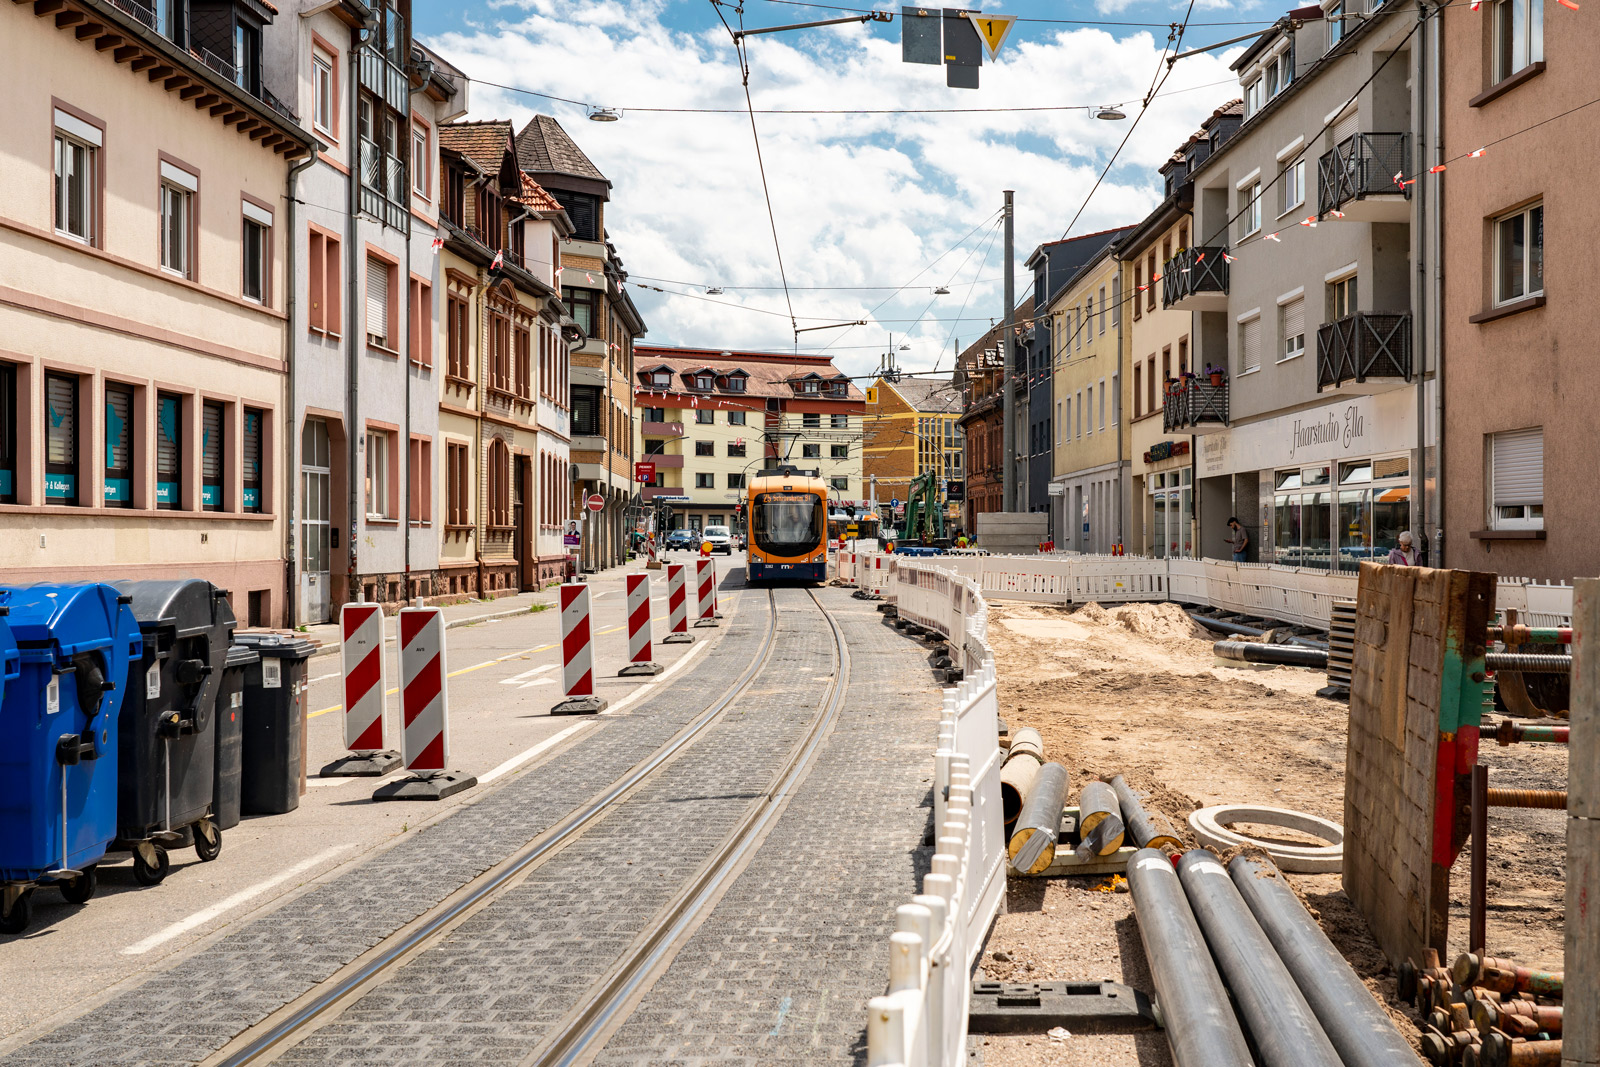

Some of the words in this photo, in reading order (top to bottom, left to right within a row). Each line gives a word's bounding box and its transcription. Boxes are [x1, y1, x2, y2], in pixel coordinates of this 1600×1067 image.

[986, 21, 993, 37] 1
[866, 390, 872, 401] 1
[1289, 411, 1340, 460] Haarstudio
[1342, 405, 1364, 449] Ella
